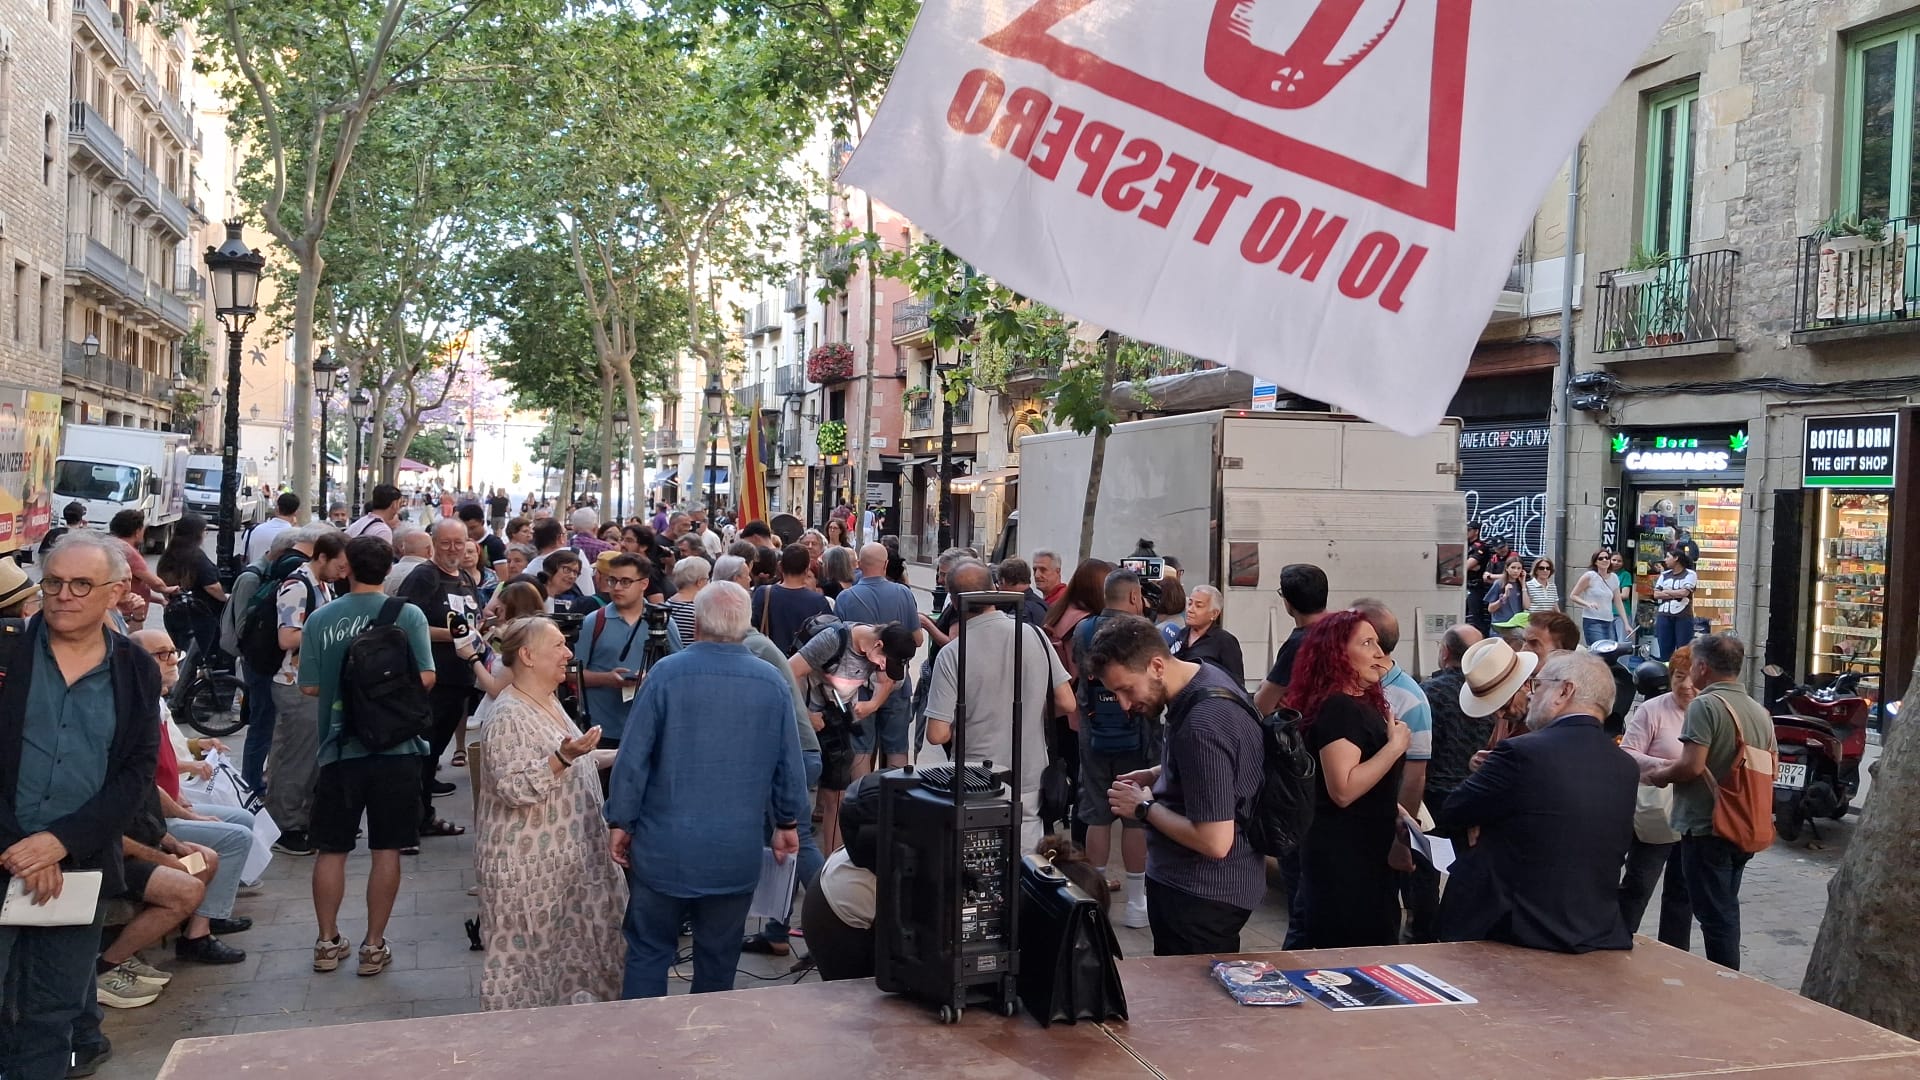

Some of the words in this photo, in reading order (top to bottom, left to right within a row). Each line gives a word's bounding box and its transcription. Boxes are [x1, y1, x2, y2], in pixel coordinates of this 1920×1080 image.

[1479, 432, 1486, 448] A
[1527, 429, 1541, 446] ON
[1810, 429, 1853, 450] BOTIGA
[1857, 427, 1891, 448] BORN
[1811, 456, 1831, 471] THE
[1833, 456, 1857, 471] GIFT
[1859, 455, 1888, 470] SHOP
[1778, 764, 1804, 776] 0872
